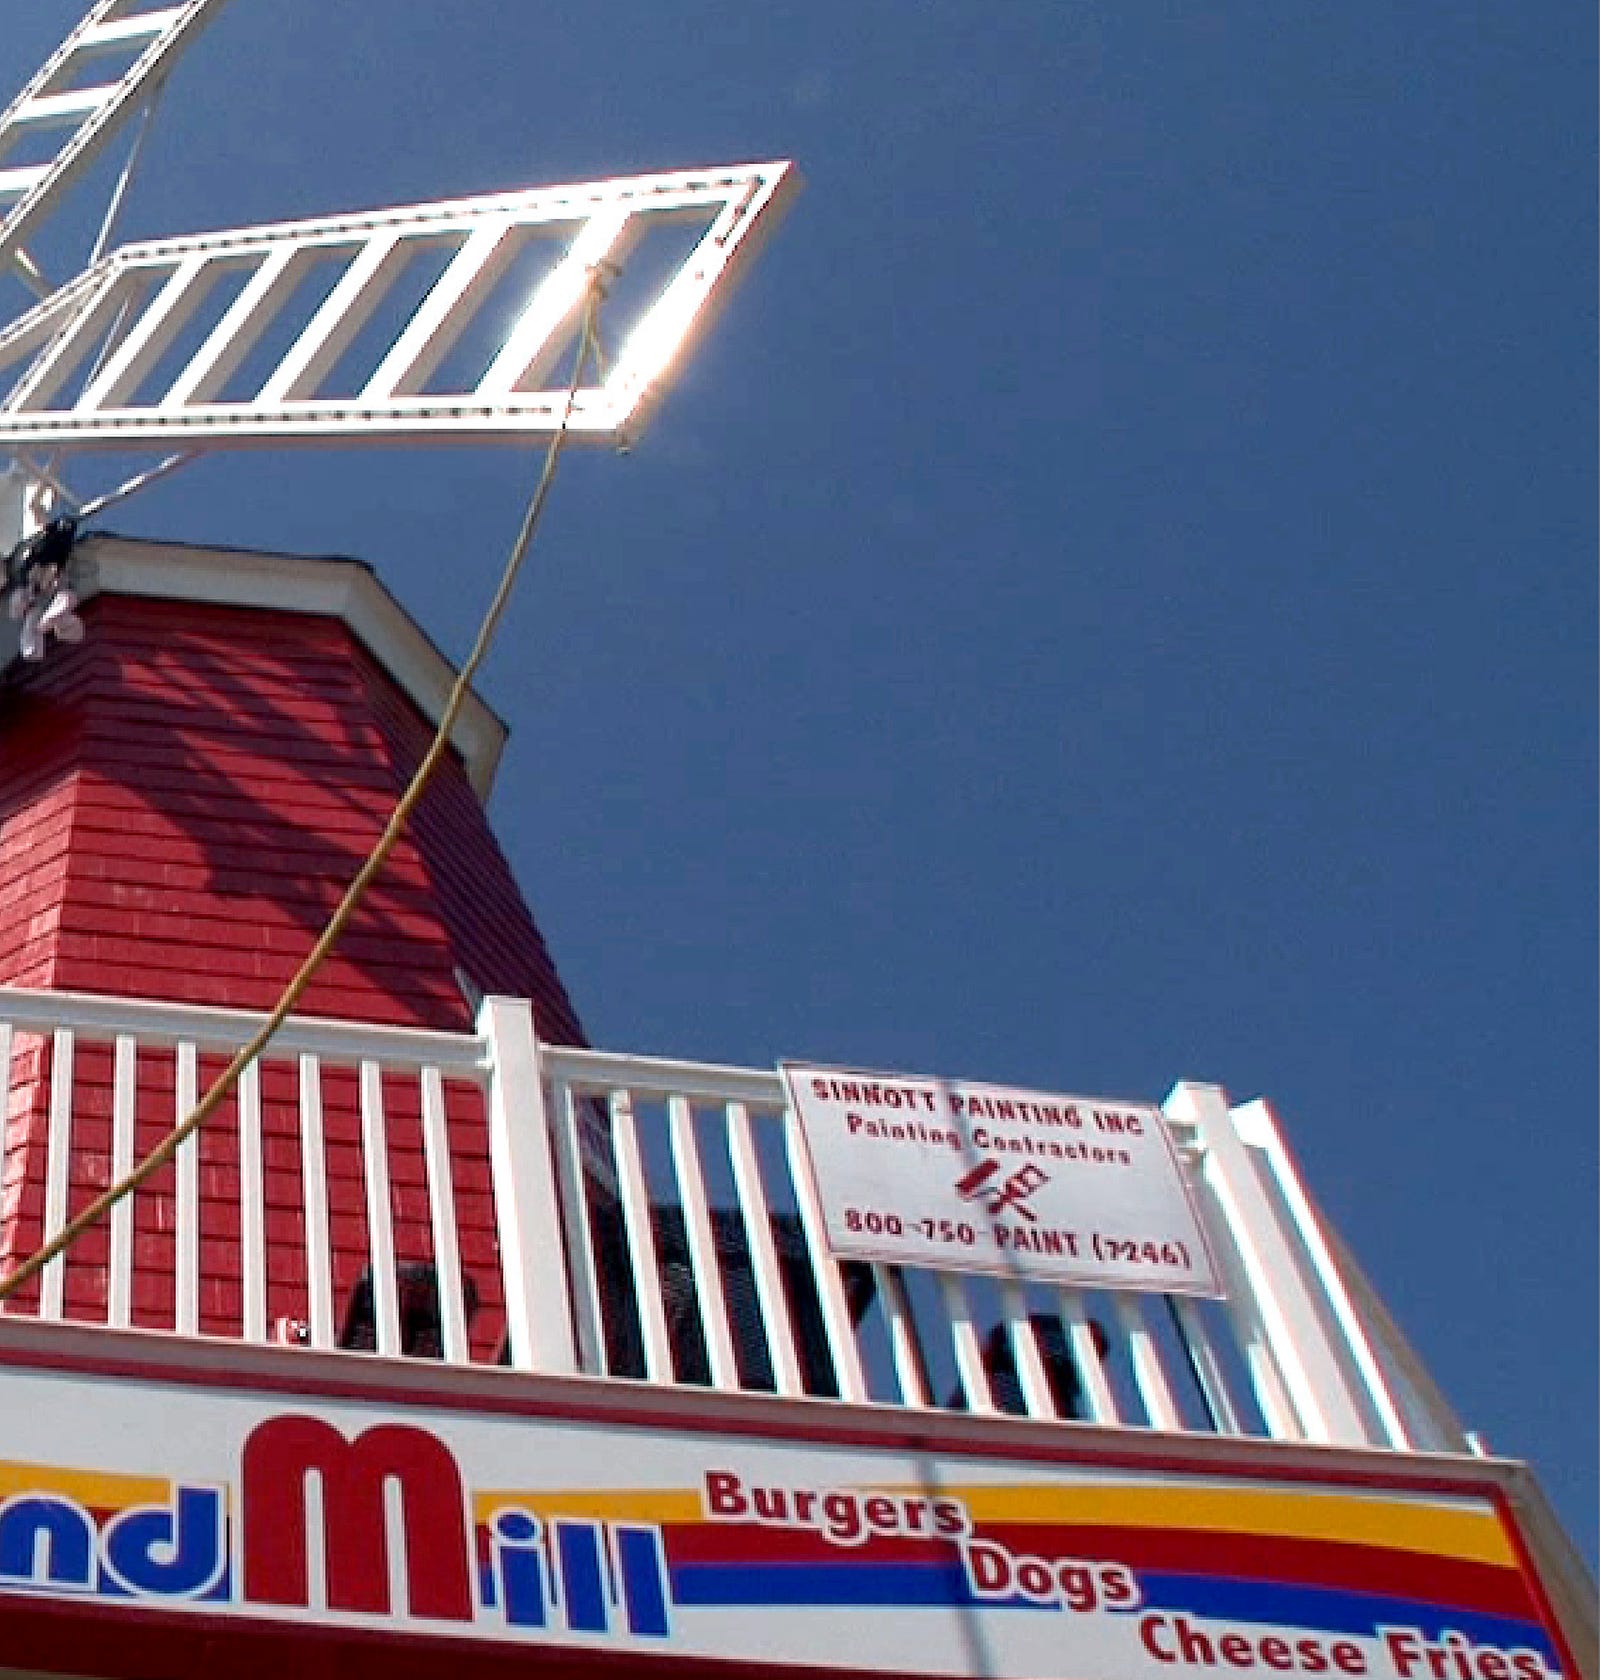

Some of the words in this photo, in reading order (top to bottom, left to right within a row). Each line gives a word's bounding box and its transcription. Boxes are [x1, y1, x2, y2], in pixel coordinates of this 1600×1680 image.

[847, 1111, 961, 1151] Painting
[973, 1128, 1132, 1166] Contractors
[949, 1093, 1083, 1129] PAINTING
[1092, 1110, 1145, 1135] INC
[704, 1470, 966, 1539] Burgers
[969, 1545, 1133, 1612] Dogs
[1138, 1616, 1369, 1674] Cheese
[1382, 1632, 1546, 1680] Fries
